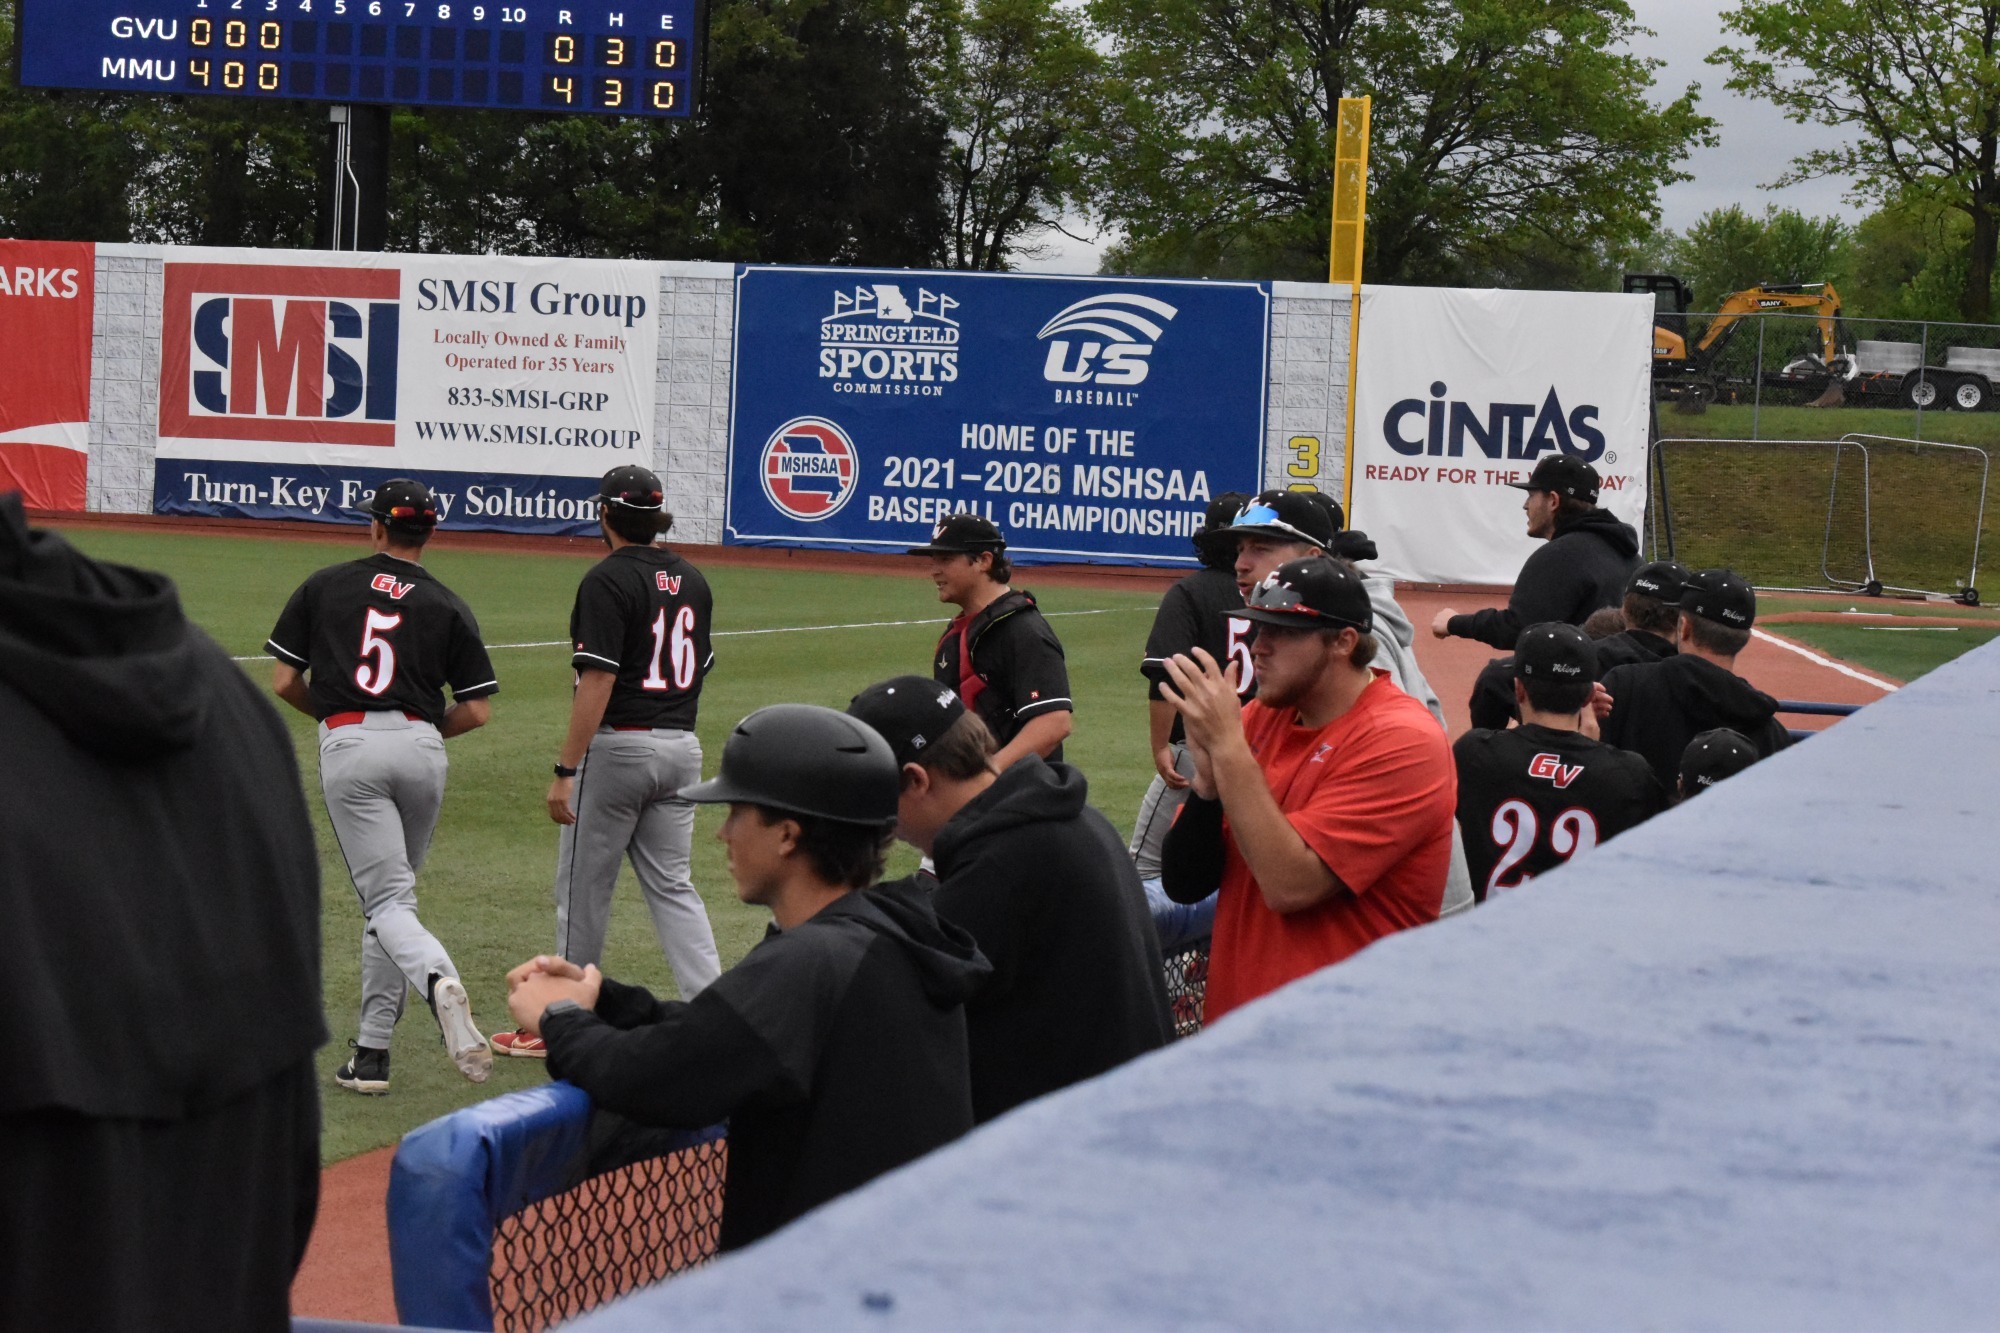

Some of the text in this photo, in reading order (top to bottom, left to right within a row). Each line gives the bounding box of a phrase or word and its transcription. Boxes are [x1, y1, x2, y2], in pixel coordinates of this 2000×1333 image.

[231, 0, 242, 9] 2
[265, 0, 278, 10] 3
[299, 0, 312, 12] 4
[334, 0, 346, 14] 5
[368, 1, 381, 15] 6
[404, 3, 415, 17] 7
[438, 5, 450, 19] 8
[473, 6, 484, 21] 9
[501, 8, 526, 22] 10
[559, 10, 572, 25] R
[609, 13, 623, 27] H
[661, 15, 673, 29] E
[111, 17, 675, 68] GVU 0 0 0 0 3 0
[102, 57, 673, 109] MMU 4 0 0 4 3 0
[417, 278, 646, 328] SMSI Group
[434, 329, 627, 353] Locally Owned & Family
[821, 323, 960, 345] SPRINGFIELD
[193, 297, 400, 421] SMSI
[445, 353, 615, 374] Operated for 35 Years
[819, 348, 958, 382] SPORTS
[1043, 340, 1153, 385] US
[447, 386, 609, 412] 833-SMSI-GRP
[833, 382, 943, 396] COMMISSION
[415, 421, 641, 450] WWW.SMSI.GROUP
[961, 423, 1135, 457] HOME OF THE
[781, 456, 839, 475] MSHSAA
[1365, 464, 1429, 482] READY
[1437, 468, 1476, 484] FOR
[1484, 470, 1520, 485] THE
[184, 472, 330, 514] Turn-Key
[1073, 464, 1211, 502] MSHSAA
[1009, 501, 1206, 537] CHAMPIONSHIP
[371, 573, 415, 600] GV
[655, 571, 682, 596] GV
[1636, 579, 1659, 591] Vikings
[1722, 608, 1746, 623] Vikings
[354, 606, 401, 695] 5
[643, 605, 696, 690] 16
[1552, 663, 1581, 676] Vikings
[1528, 753, 1584, 789] GV
